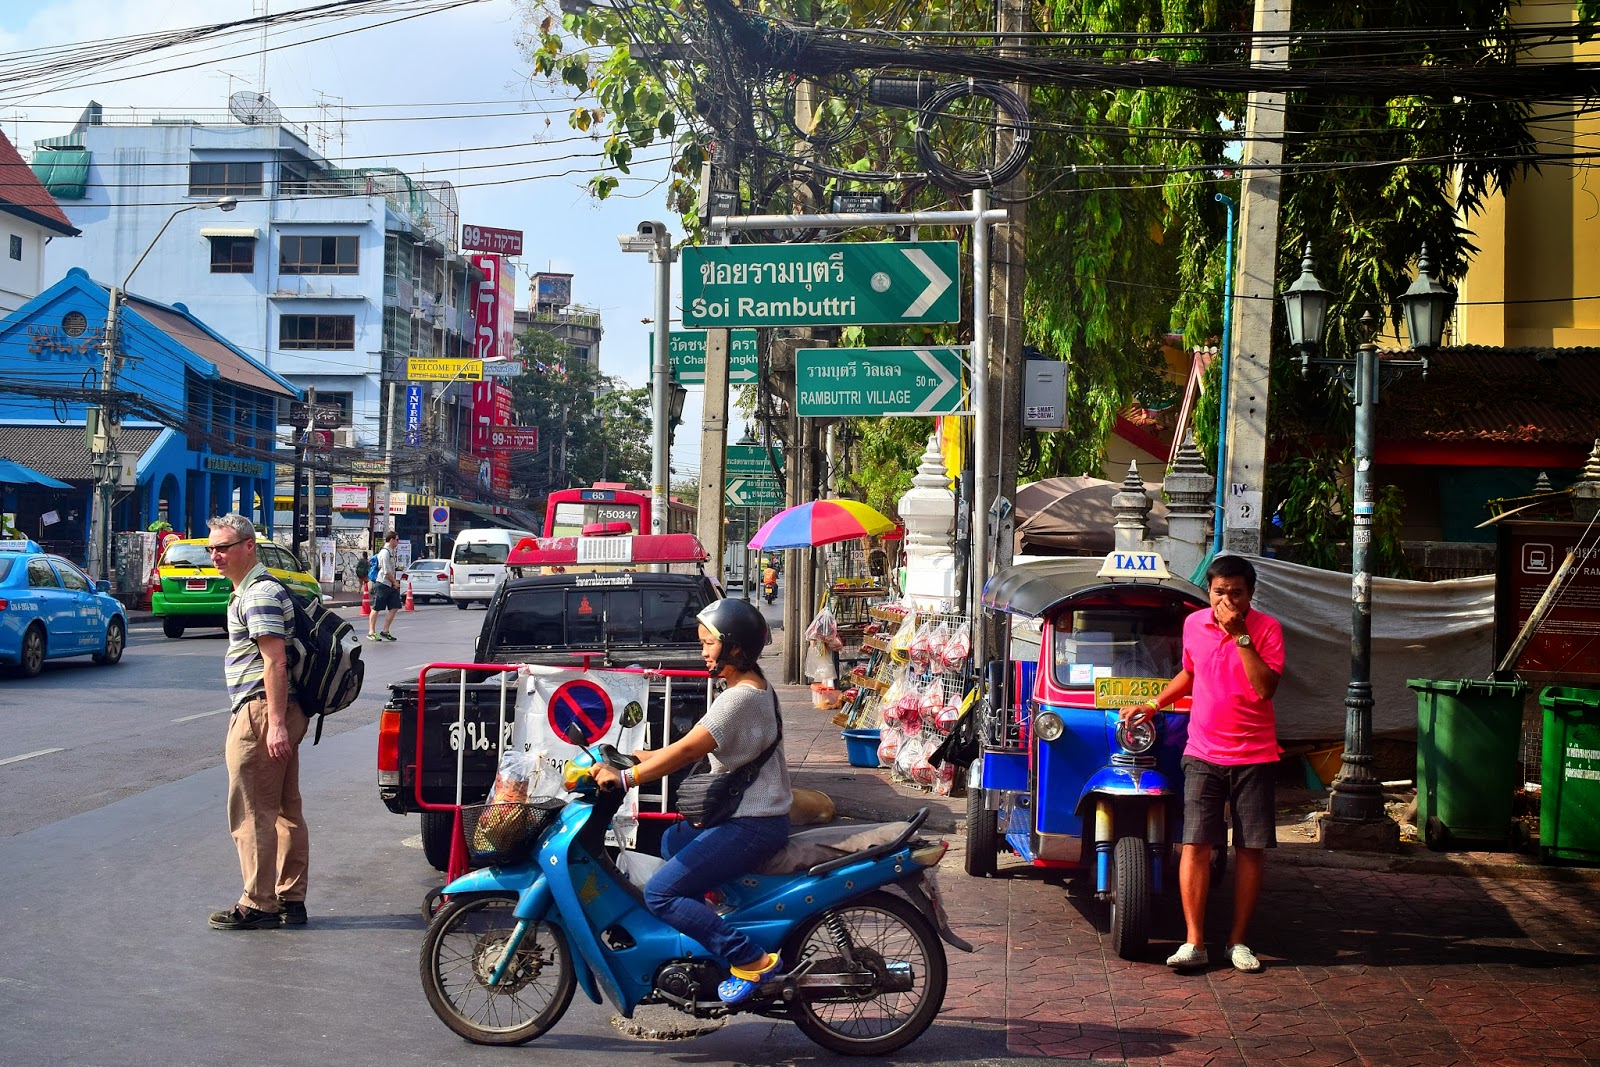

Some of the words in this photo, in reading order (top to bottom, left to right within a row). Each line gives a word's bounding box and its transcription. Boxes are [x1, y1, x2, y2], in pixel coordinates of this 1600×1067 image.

[700, 252, 843, 292] ซอยรามบุตรี
[691, 298, 730, 318] Soi
[738, 296, 856, 317] Rambuttri
[683, 355, 706, 365] Cha
[411, 363, 450, 371] WELCOME
[807, 361, 857, 381] รามบุตรี
[862, 361, 902, 377] วิลเลจ
[916, 376, 926, 387] 50
[801, 391, 861, 405] RAMBUTTRI
[866, 390, 911, 404] VILLAGE
[592, 492, 605, 500] 65
[598, 510, 638, 519] 7-50347
[1241, 505, 1250, 518] 2
[851, 551, 864, 560] 100
[1113, 554, 1157, 571] TAXI
